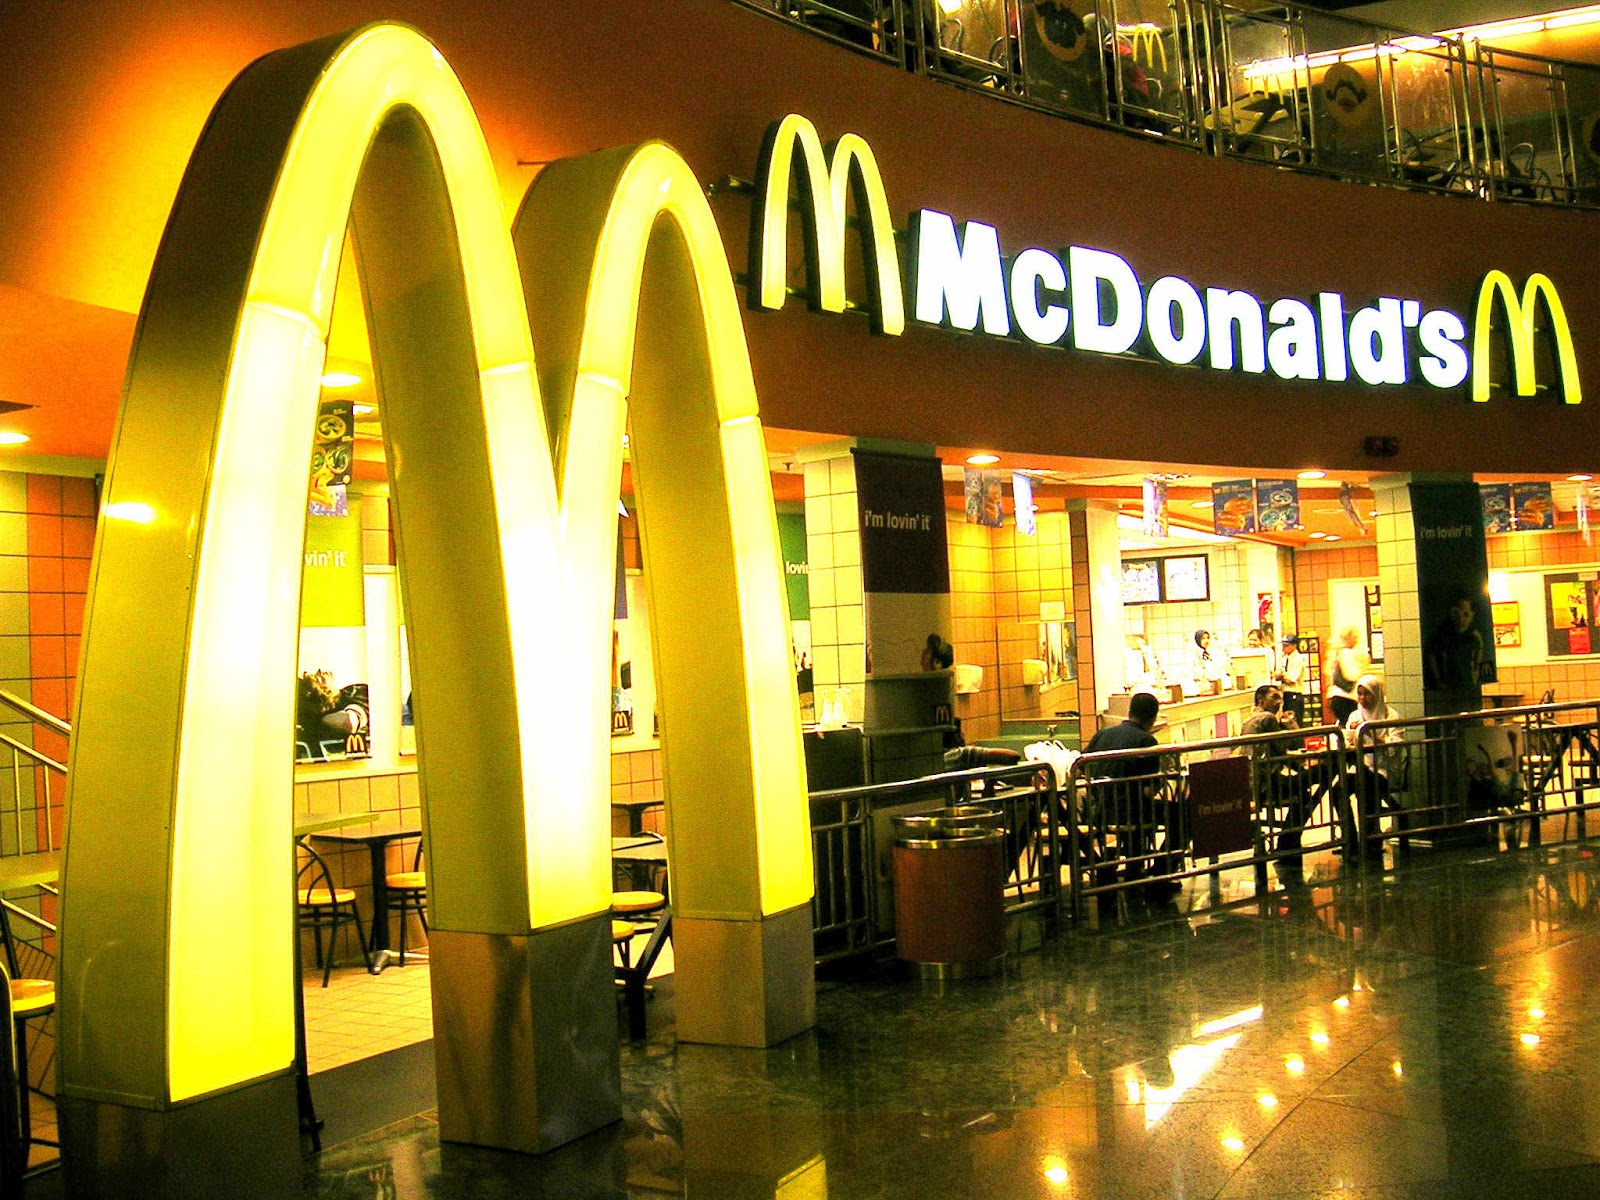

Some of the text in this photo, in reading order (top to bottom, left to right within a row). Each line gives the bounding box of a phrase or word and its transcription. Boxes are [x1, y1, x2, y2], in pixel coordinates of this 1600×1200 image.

[915, 208, 1470, 390] McDonald's
[864, 510, 931, 531] i'm lovin' it
[304, 550, 332, 566] vin'
[785, 561, 808, 575] lovi
